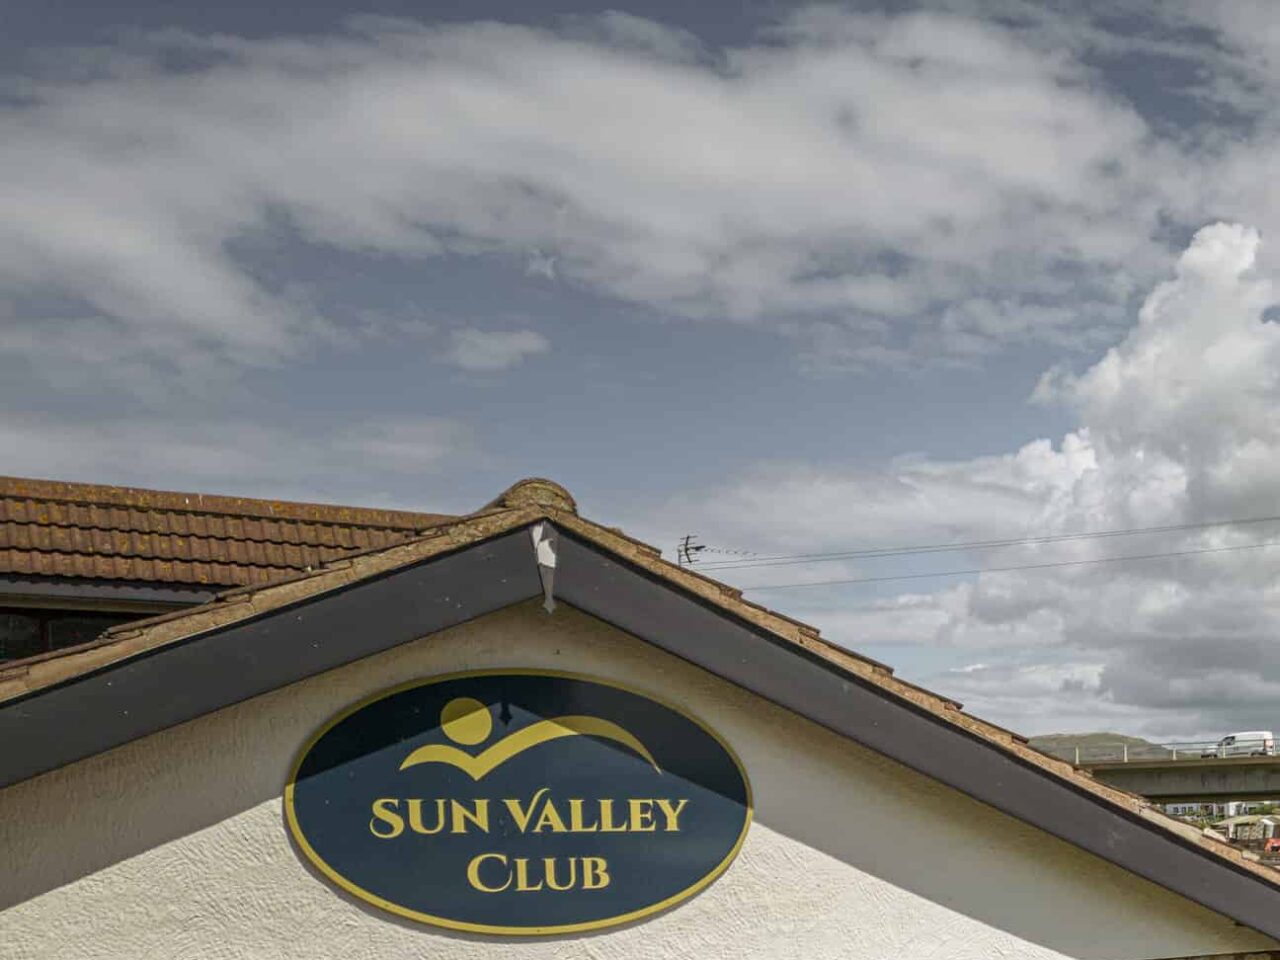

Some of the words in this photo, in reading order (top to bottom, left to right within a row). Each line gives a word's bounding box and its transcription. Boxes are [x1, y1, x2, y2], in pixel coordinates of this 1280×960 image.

[369, 798, 490, 839] SUN
[503, 788, 690, 834] VALLEY
[466, 853, 611, 892] CLUB
